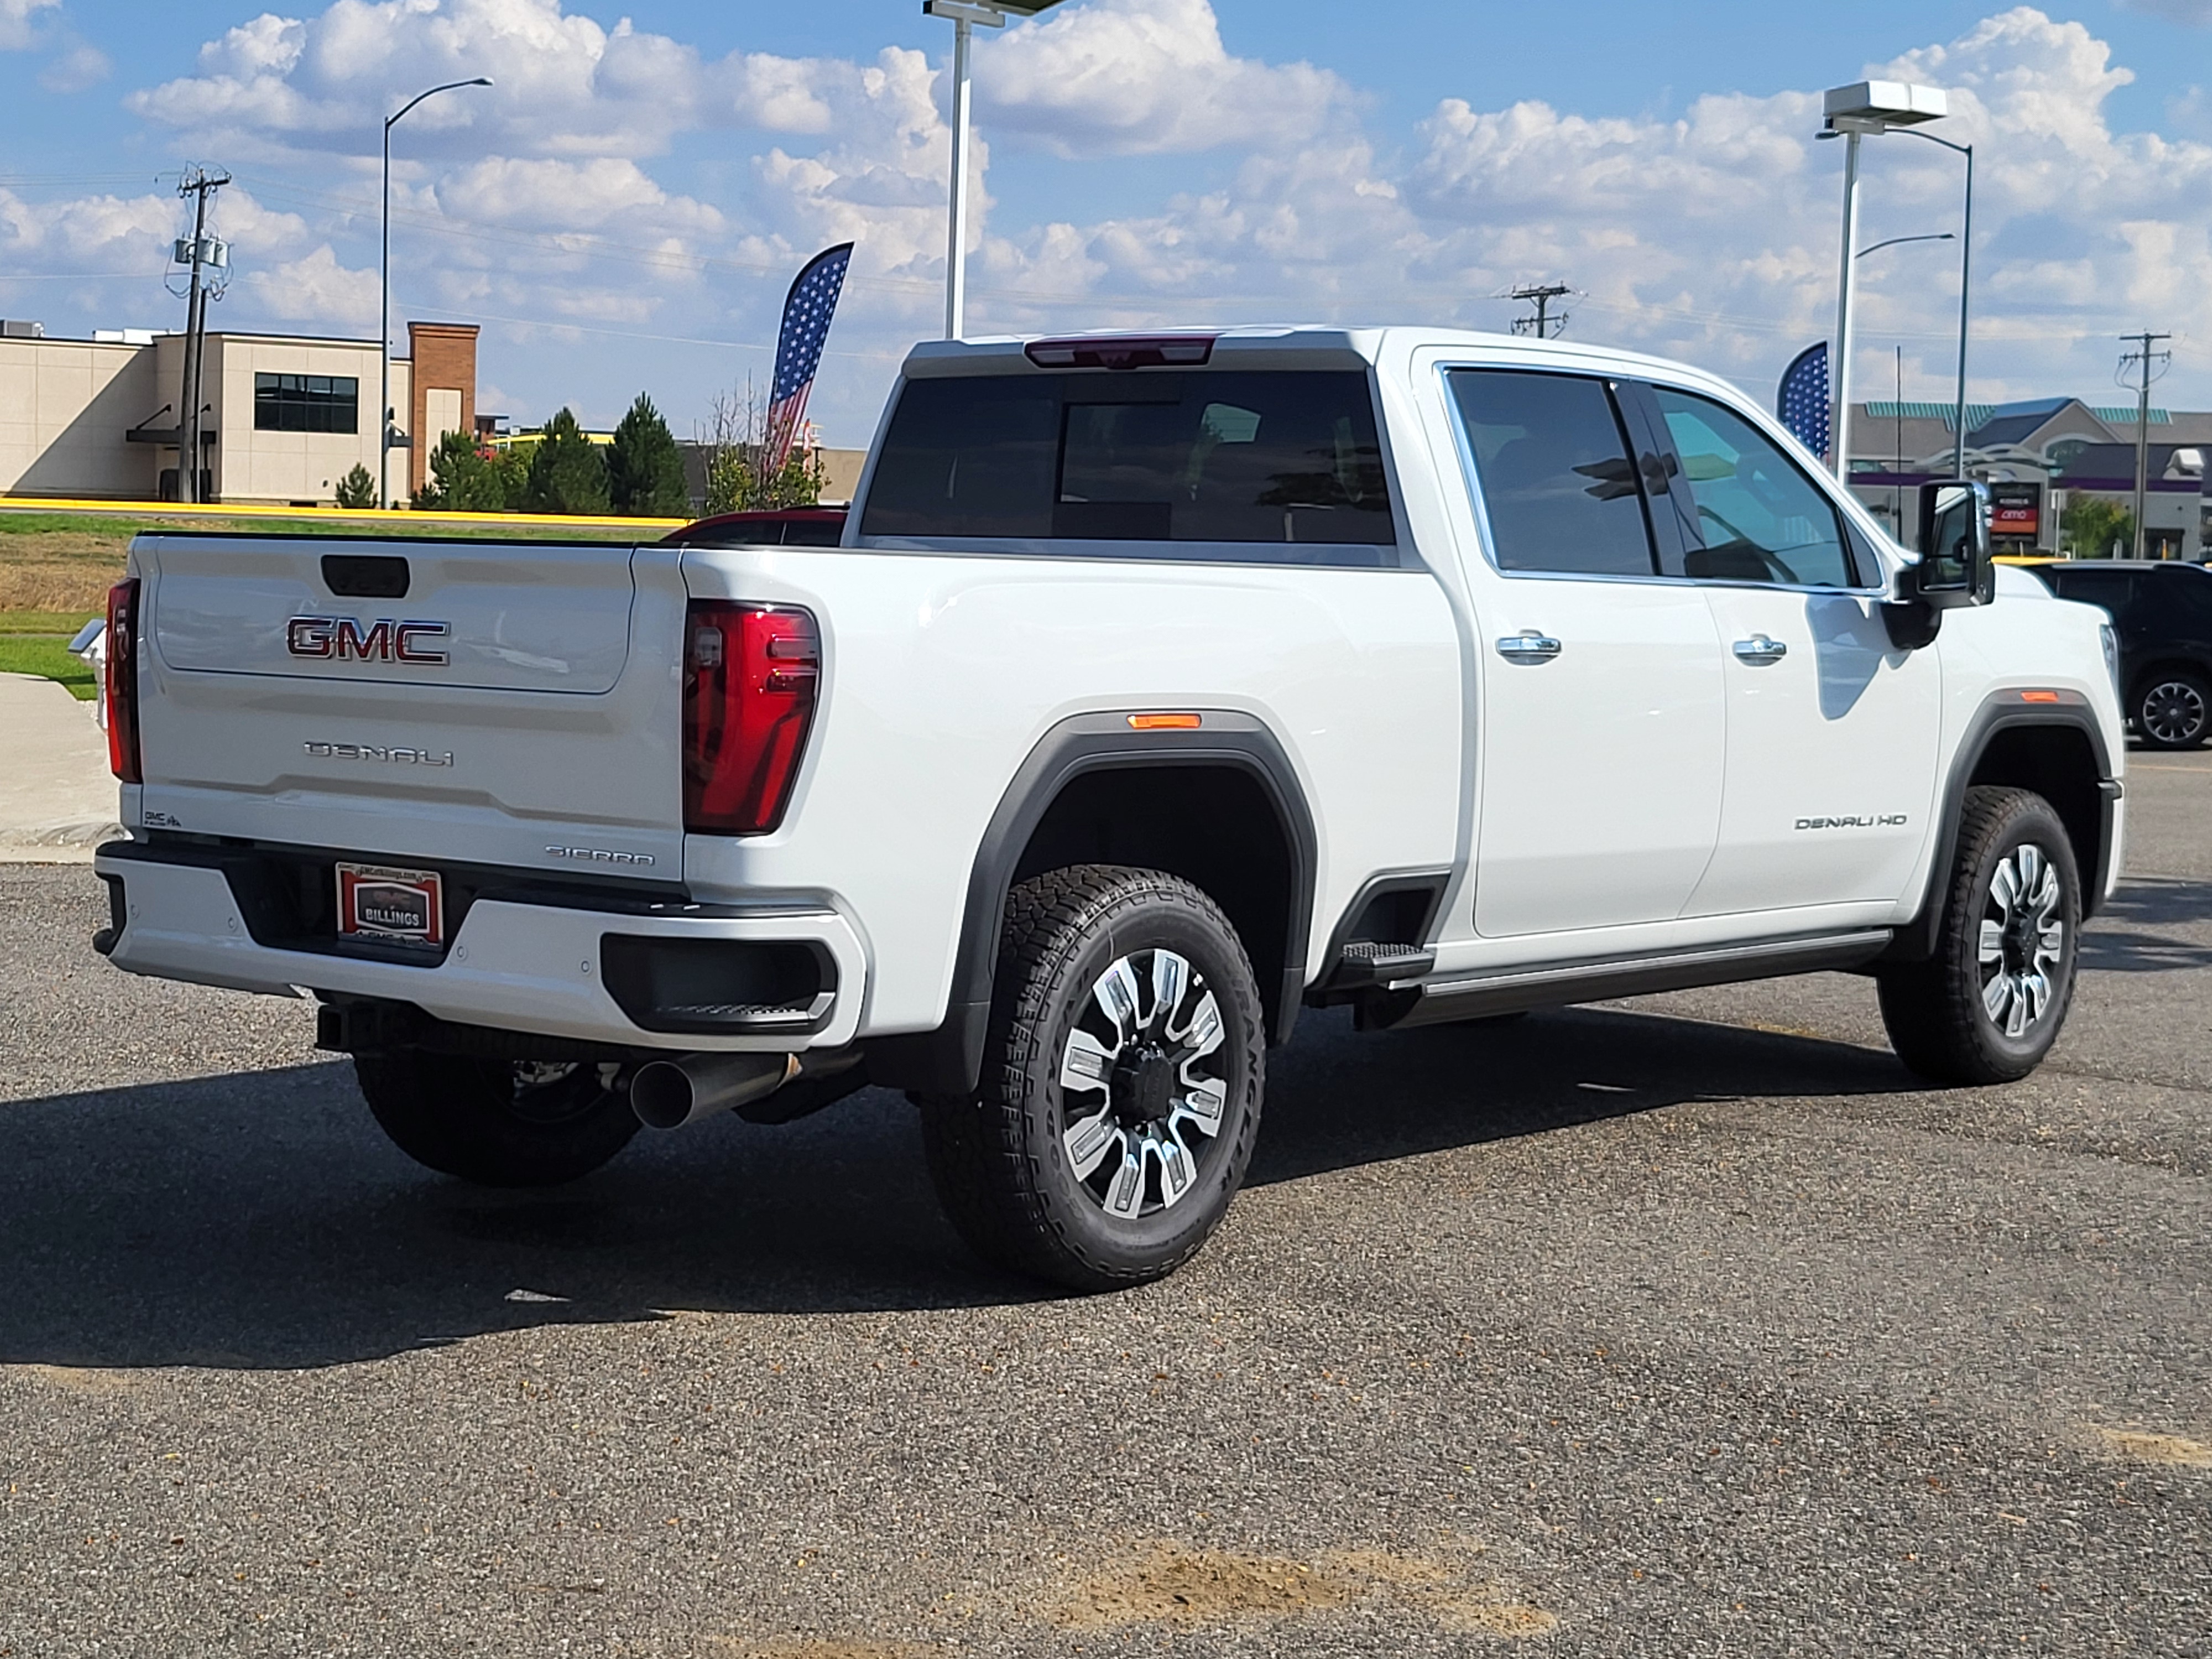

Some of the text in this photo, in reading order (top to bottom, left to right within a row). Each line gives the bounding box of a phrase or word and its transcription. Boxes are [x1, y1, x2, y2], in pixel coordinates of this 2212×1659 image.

[286, 614, 451, 666] GMC
[304, 741, 453, 767] DENALI
[1794, 814, 1907, 830] DENALI HD
[545, 844, 655, 866] SIERRA
[365, 906, 419, 927] BILLINGS
